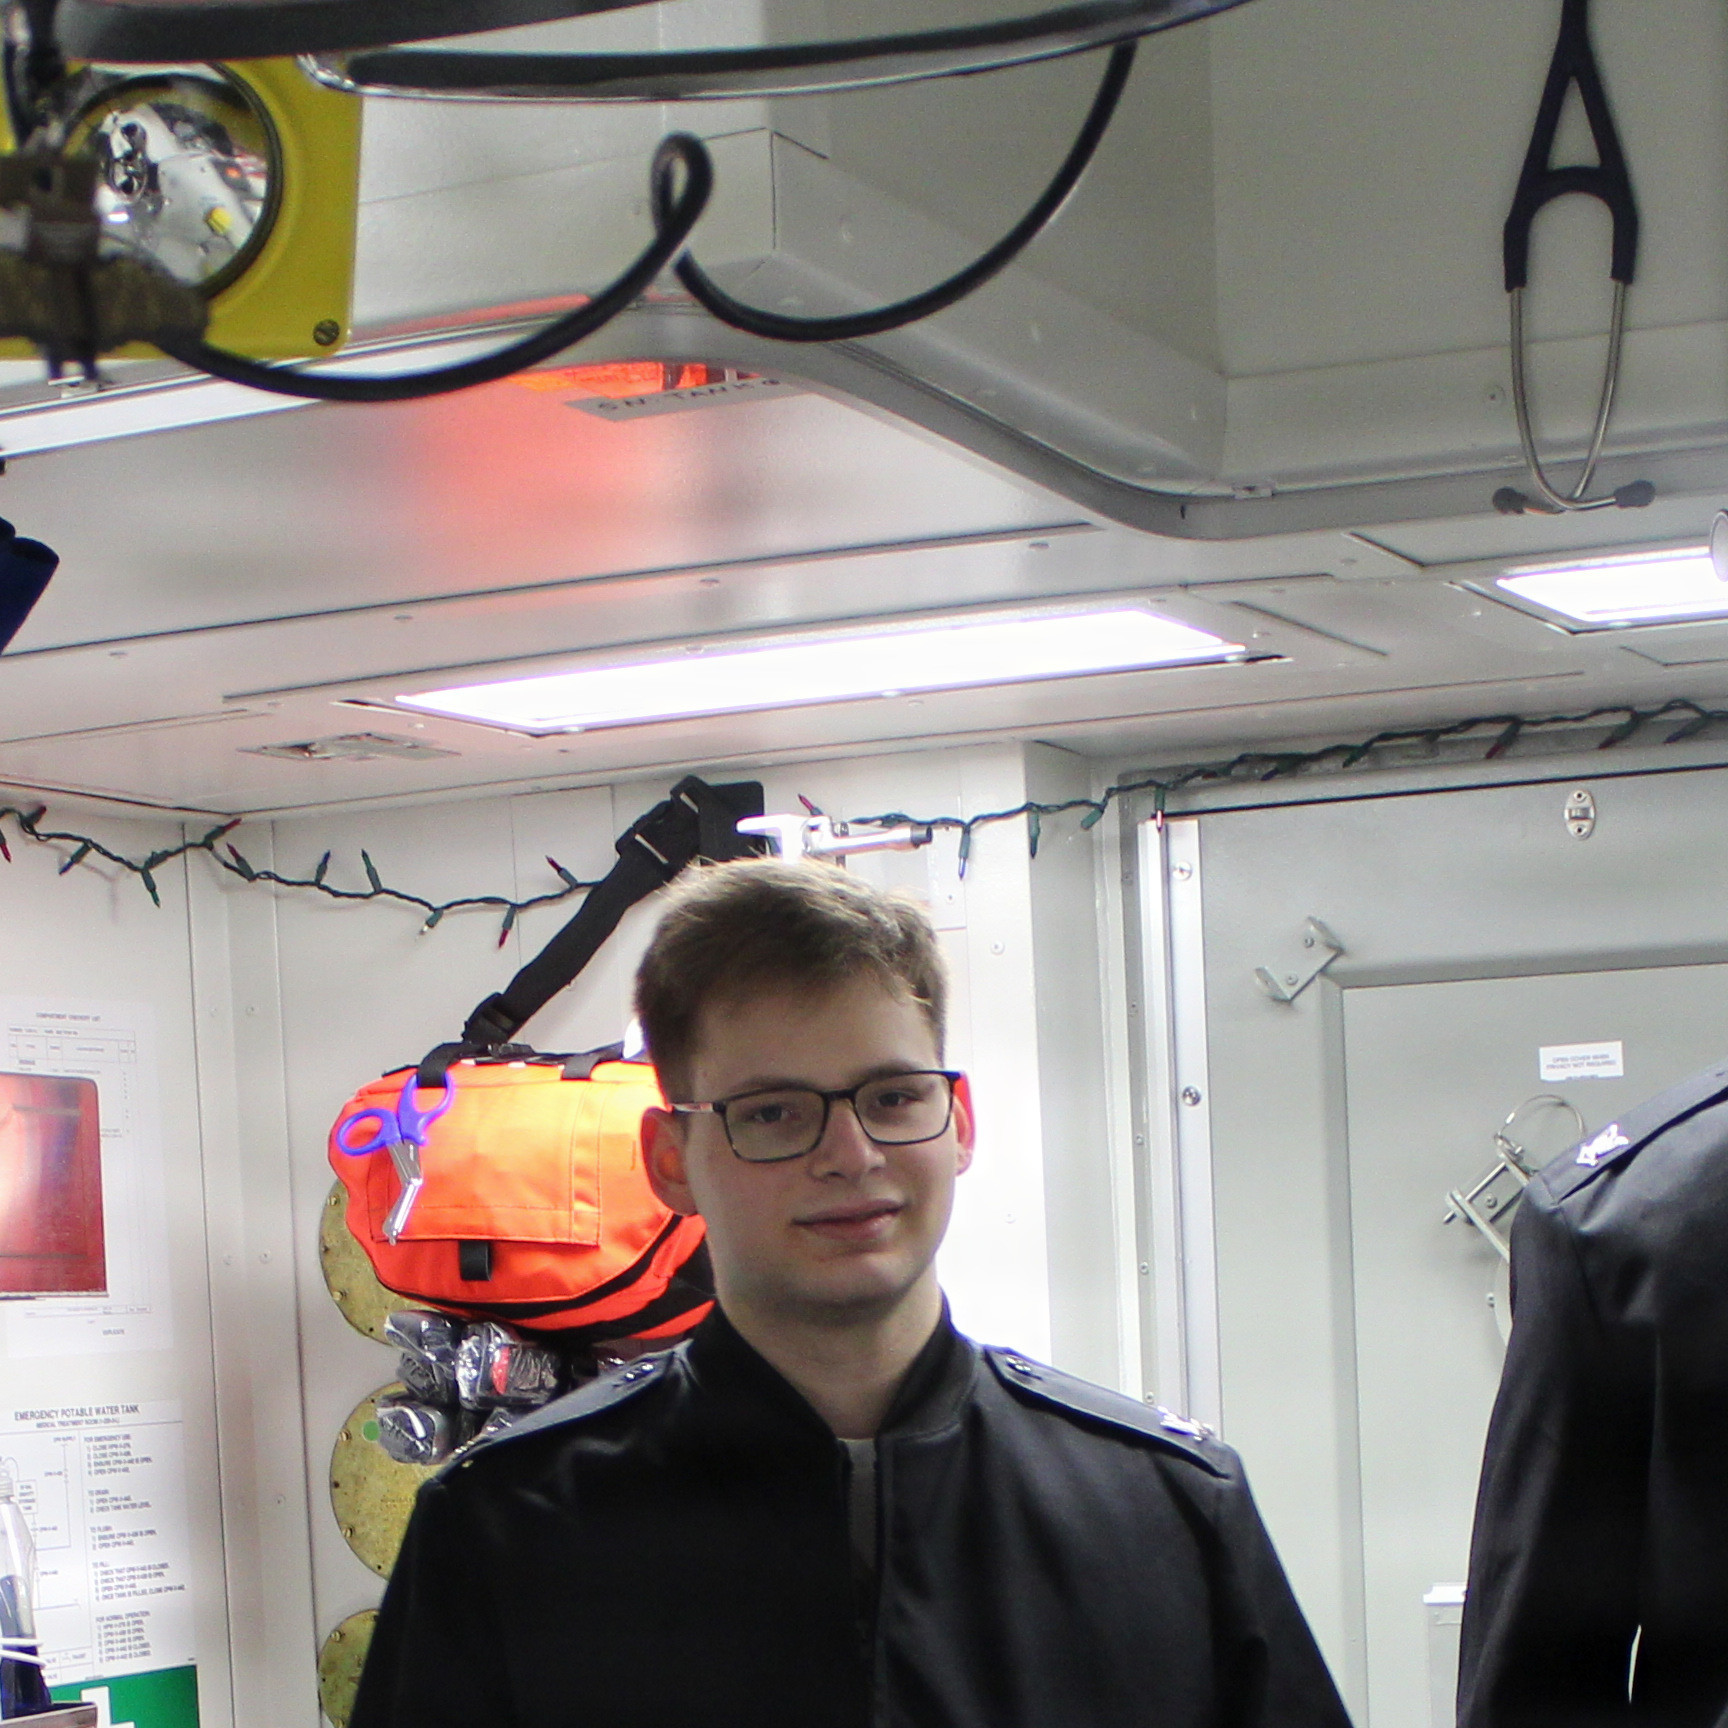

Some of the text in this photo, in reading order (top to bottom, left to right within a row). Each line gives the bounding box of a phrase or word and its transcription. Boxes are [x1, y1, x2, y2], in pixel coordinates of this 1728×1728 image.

[14, 1404, 139, 1421] EMERGENCY POTABLE WATER TANK
